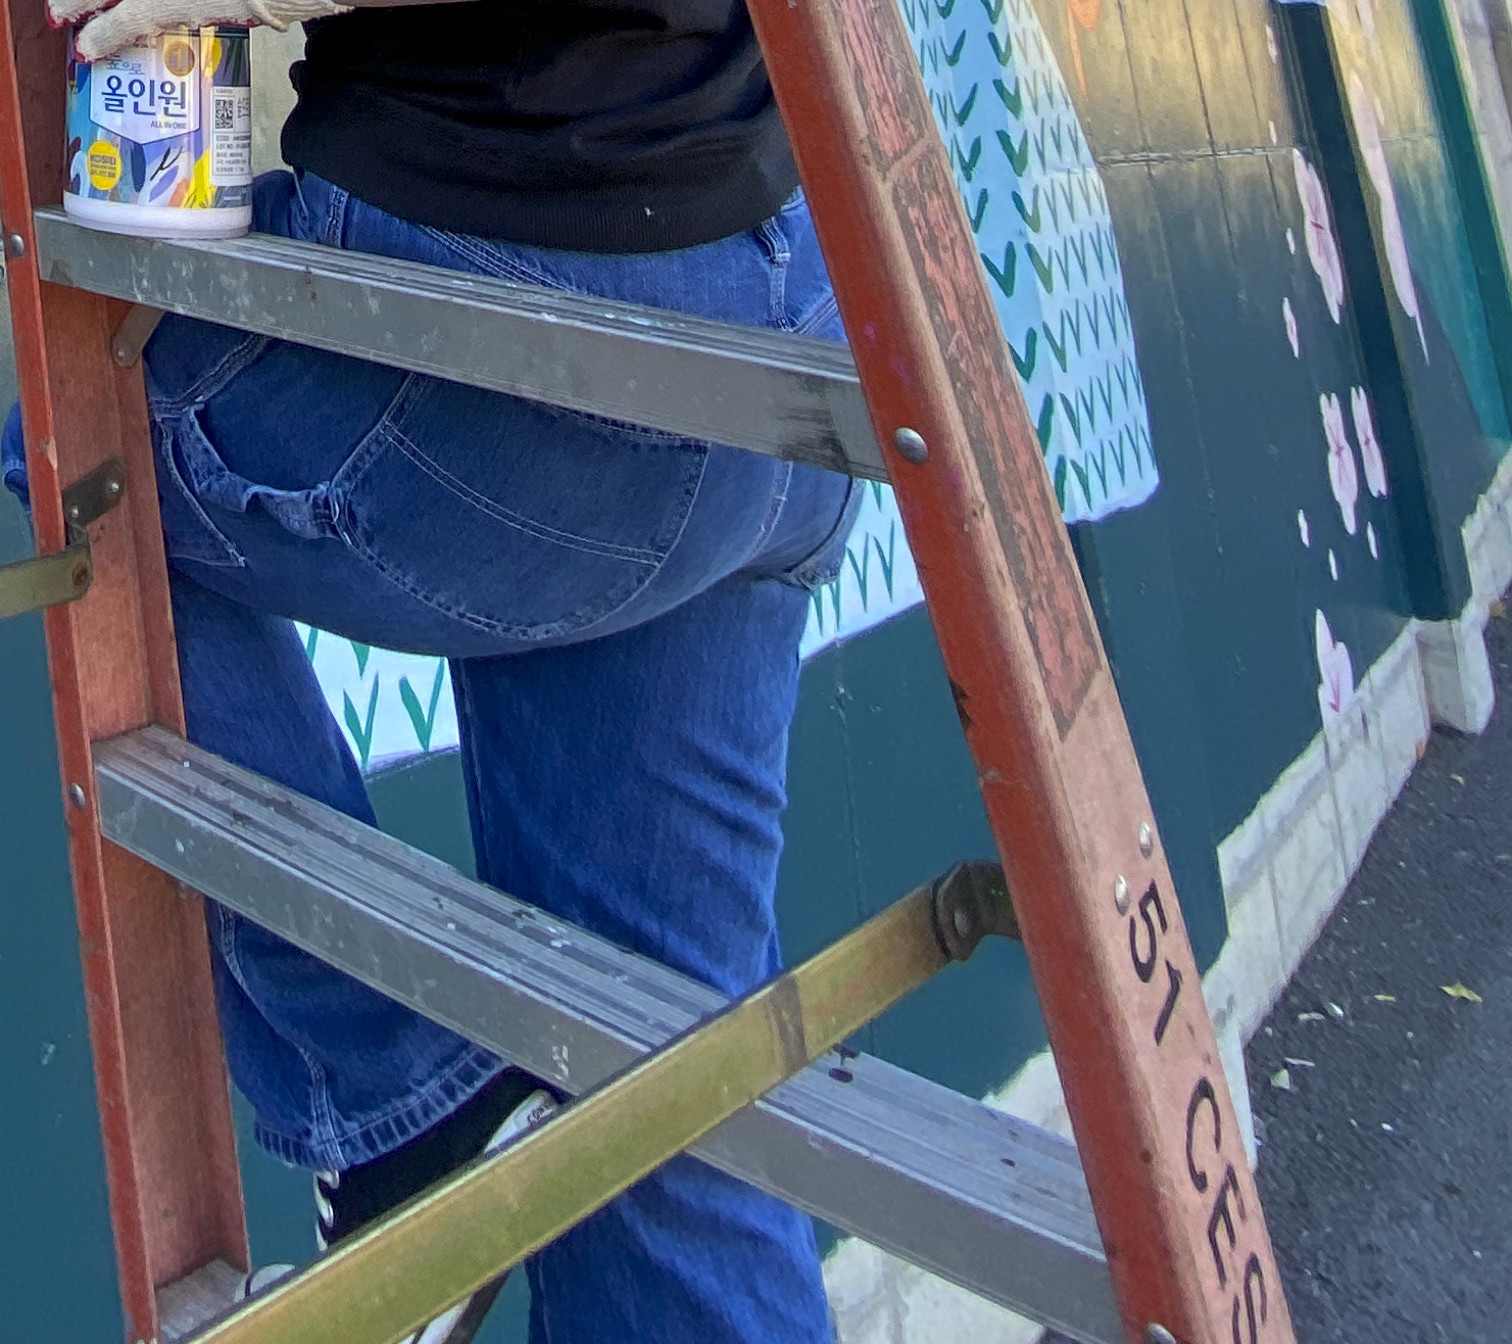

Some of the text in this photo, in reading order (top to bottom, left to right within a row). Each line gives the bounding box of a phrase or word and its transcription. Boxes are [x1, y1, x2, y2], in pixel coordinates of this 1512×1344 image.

[101, 75, 187, 117] 올인원
[150, 120, 163, 129] ALL
[1129, 879, 1268, 1344] 51 CES
